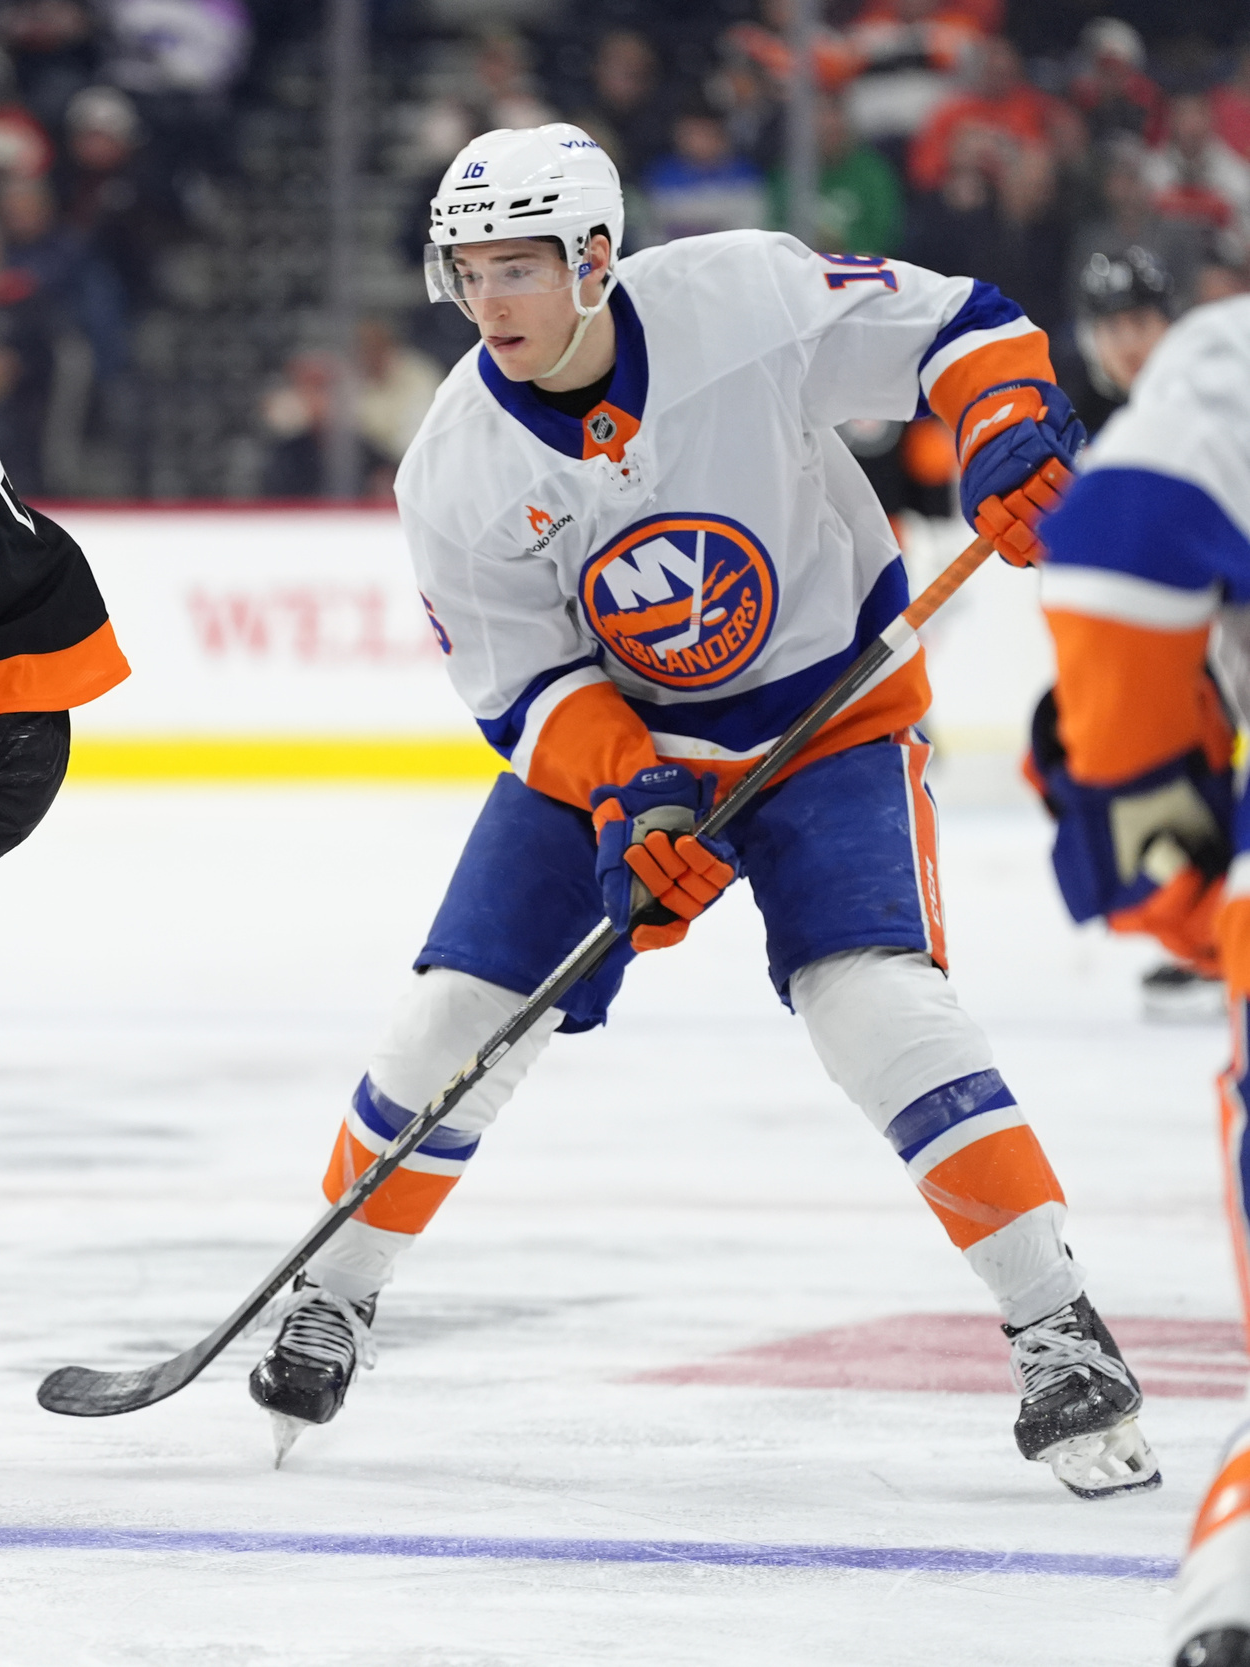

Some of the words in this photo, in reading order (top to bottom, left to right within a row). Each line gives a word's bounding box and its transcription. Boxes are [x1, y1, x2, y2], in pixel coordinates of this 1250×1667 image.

[461, 161, 488, 179] 16
[447, 200, 496, 215] CCM
[600, 529, 706, 618] NY
[618, 587, 757, 674] ISLANDERS
[641, 769, 678, 782] CCM
[924, 854, 943, 928] CCM
